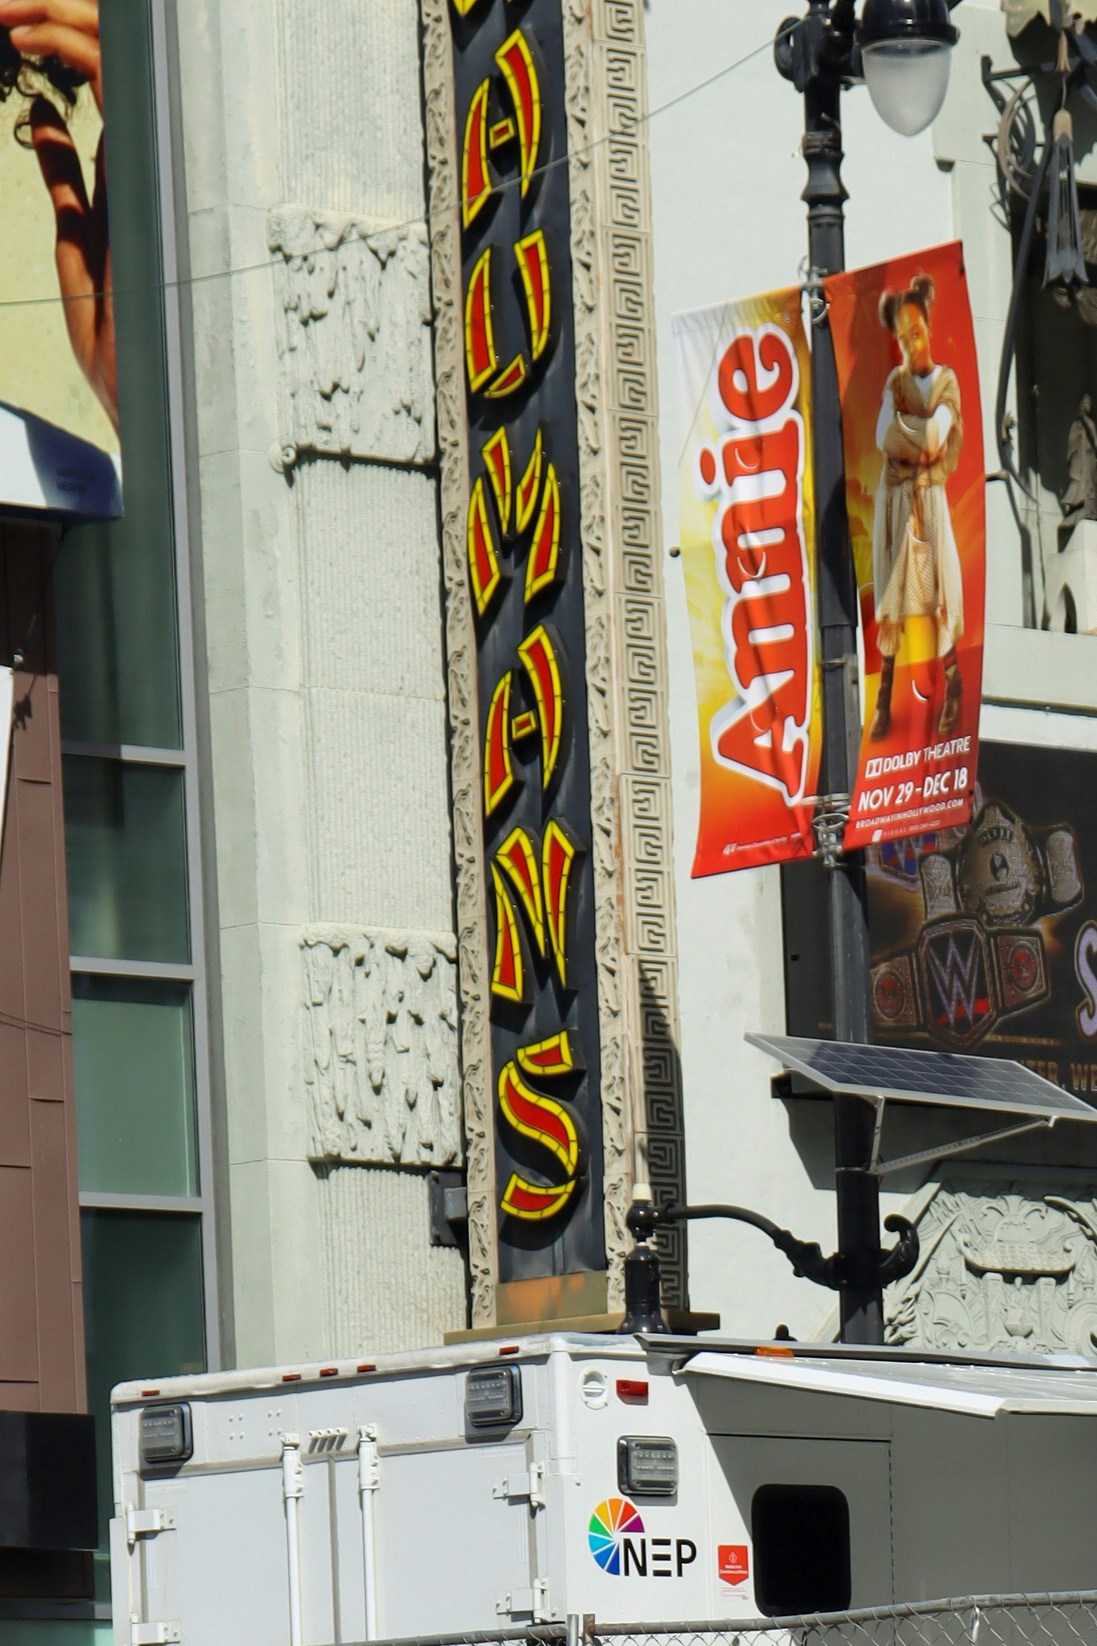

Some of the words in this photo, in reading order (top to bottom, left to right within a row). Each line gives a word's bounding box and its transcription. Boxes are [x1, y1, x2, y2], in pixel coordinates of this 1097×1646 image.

[698, 330, 809, 804] Annie
[453, 0, 580, 1221] AUMANS
[883, 751, 922, 773] DOLBY
[923, 735, 971, 762] THEATRE
[857, 785, 894, 812] NOV
[953, 766, 968, 790] 18
[623, 1537, 697, 1578] NEP
